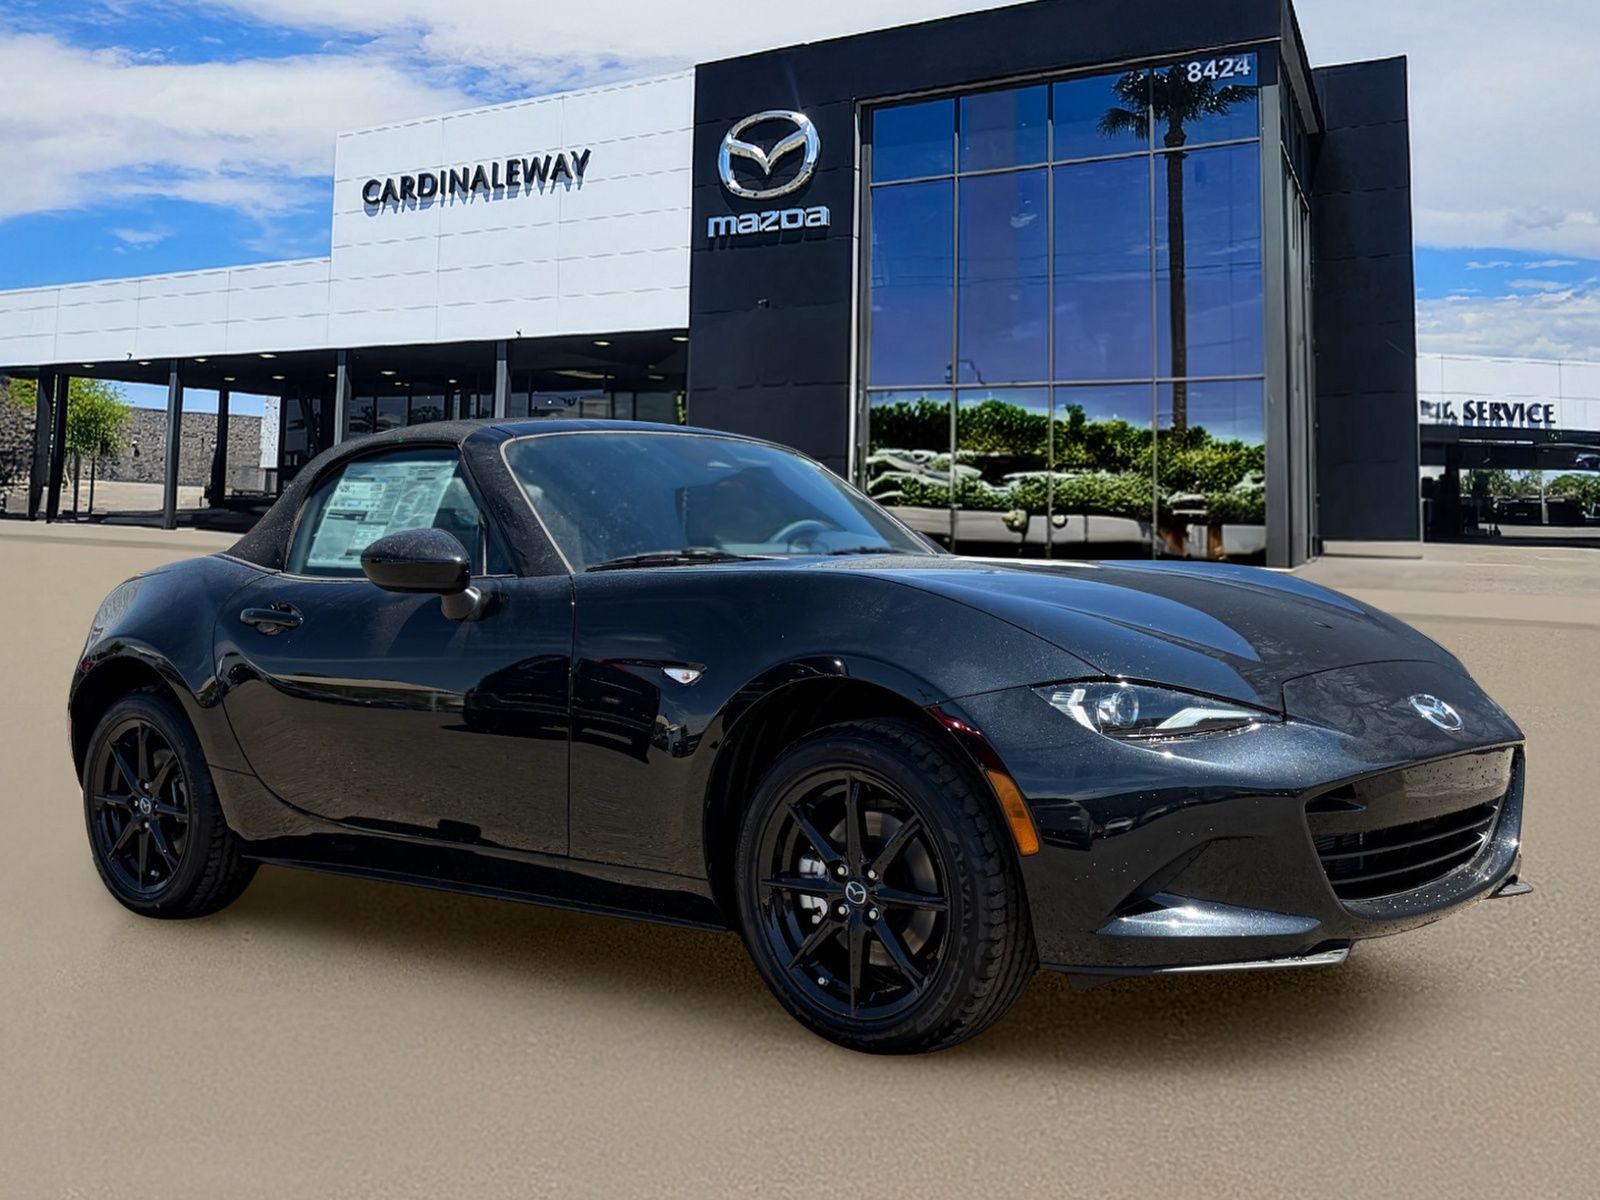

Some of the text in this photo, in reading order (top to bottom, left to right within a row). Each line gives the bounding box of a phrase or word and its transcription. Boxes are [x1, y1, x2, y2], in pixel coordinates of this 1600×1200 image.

[1187, 56, 1251, 83] 8424
[362, 148, 592, 205] CARDINALEWAY
[707, 205, 831, 238] mazda
[1463, 400, 1556, 424] SERVICE
